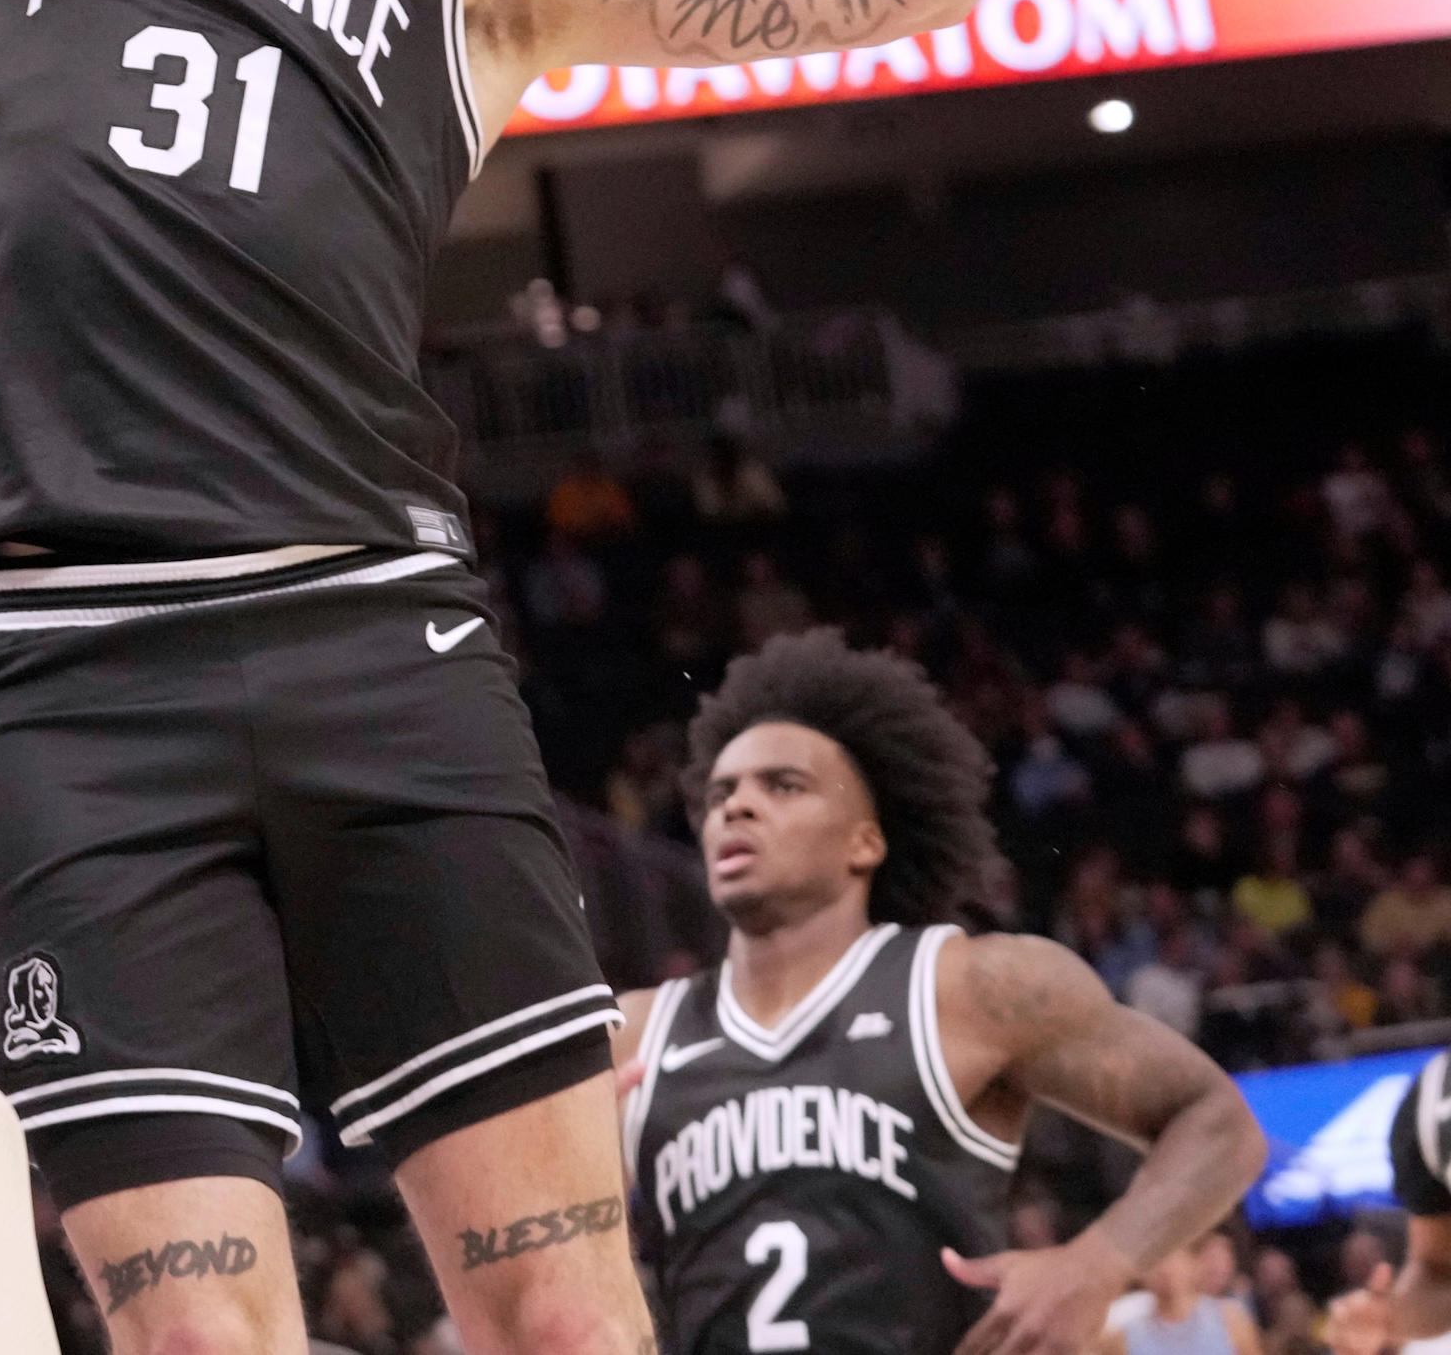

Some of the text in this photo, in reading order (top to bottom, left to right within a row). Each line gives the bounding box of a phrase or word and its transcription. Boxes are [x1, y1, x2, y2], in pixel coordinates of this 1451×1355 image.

[108, 25, 282, 194] 31
[655, 1084, 919, 1236] PROVIDENCE
[99, 1229, 258, 1317] BEYOND
[458, 1195, 623, 1273] BLESSED
[744, 1219, 811, 1354] 2
